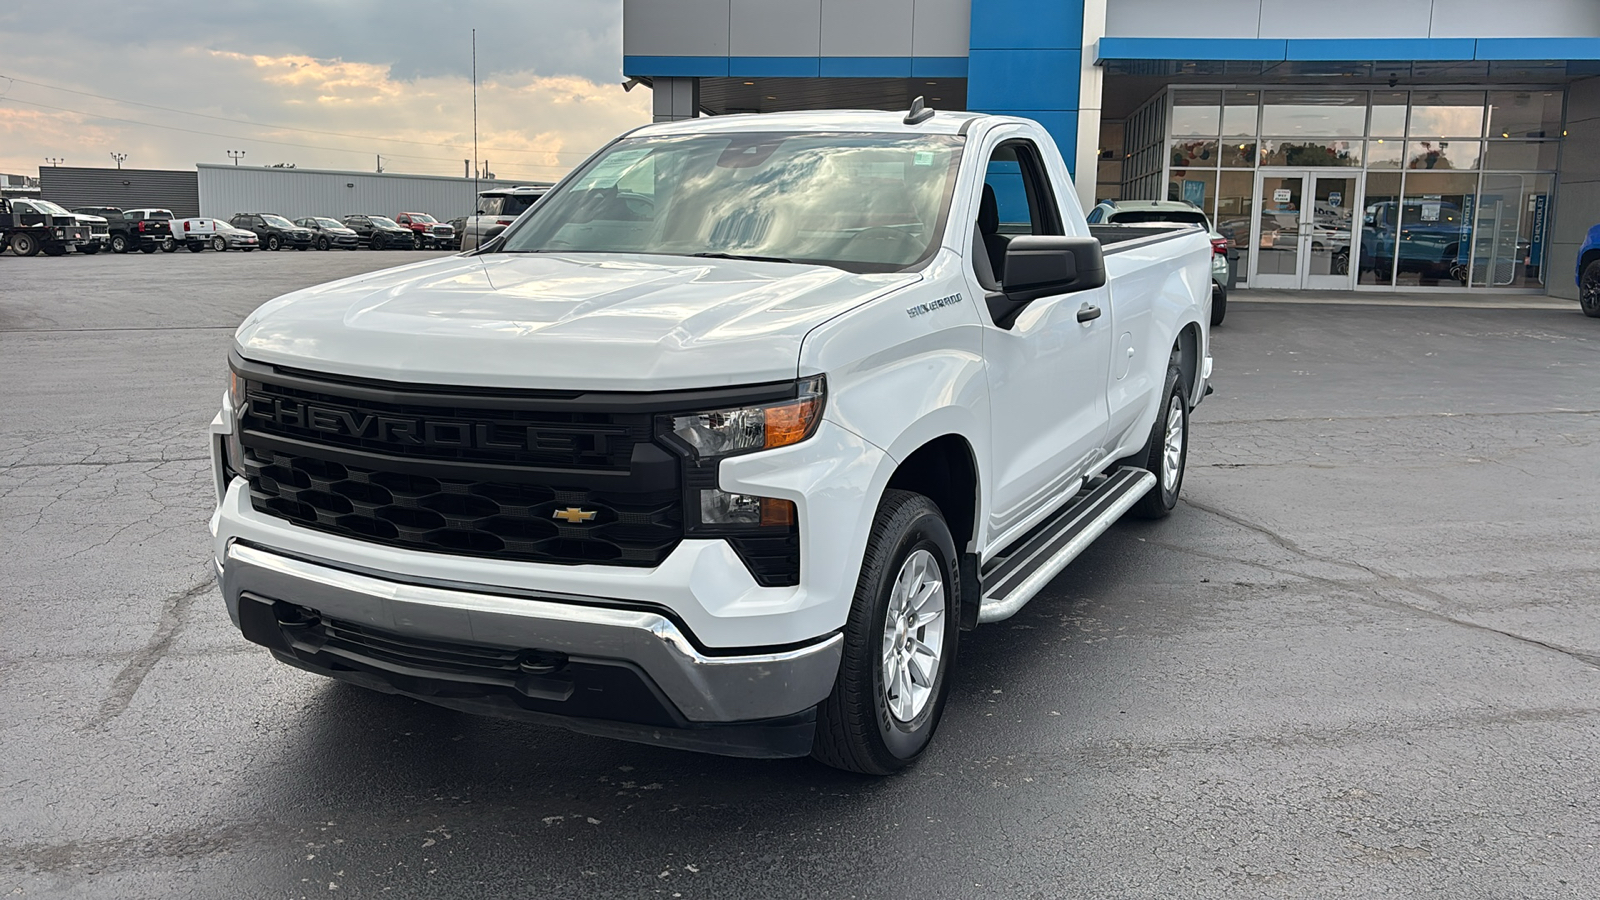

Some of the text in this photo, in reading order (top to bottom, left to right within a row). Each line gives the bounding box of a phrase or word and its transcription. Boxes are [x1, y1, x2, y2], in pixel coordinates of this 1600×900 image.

[1462, 195, 1472, 242] CHEVROLET
[1534, 198, 1544, 243] CHEVROLET
[906, 292, 963, 318] SILVERADO
[247, 396, 632, 456] CHEVROLET
